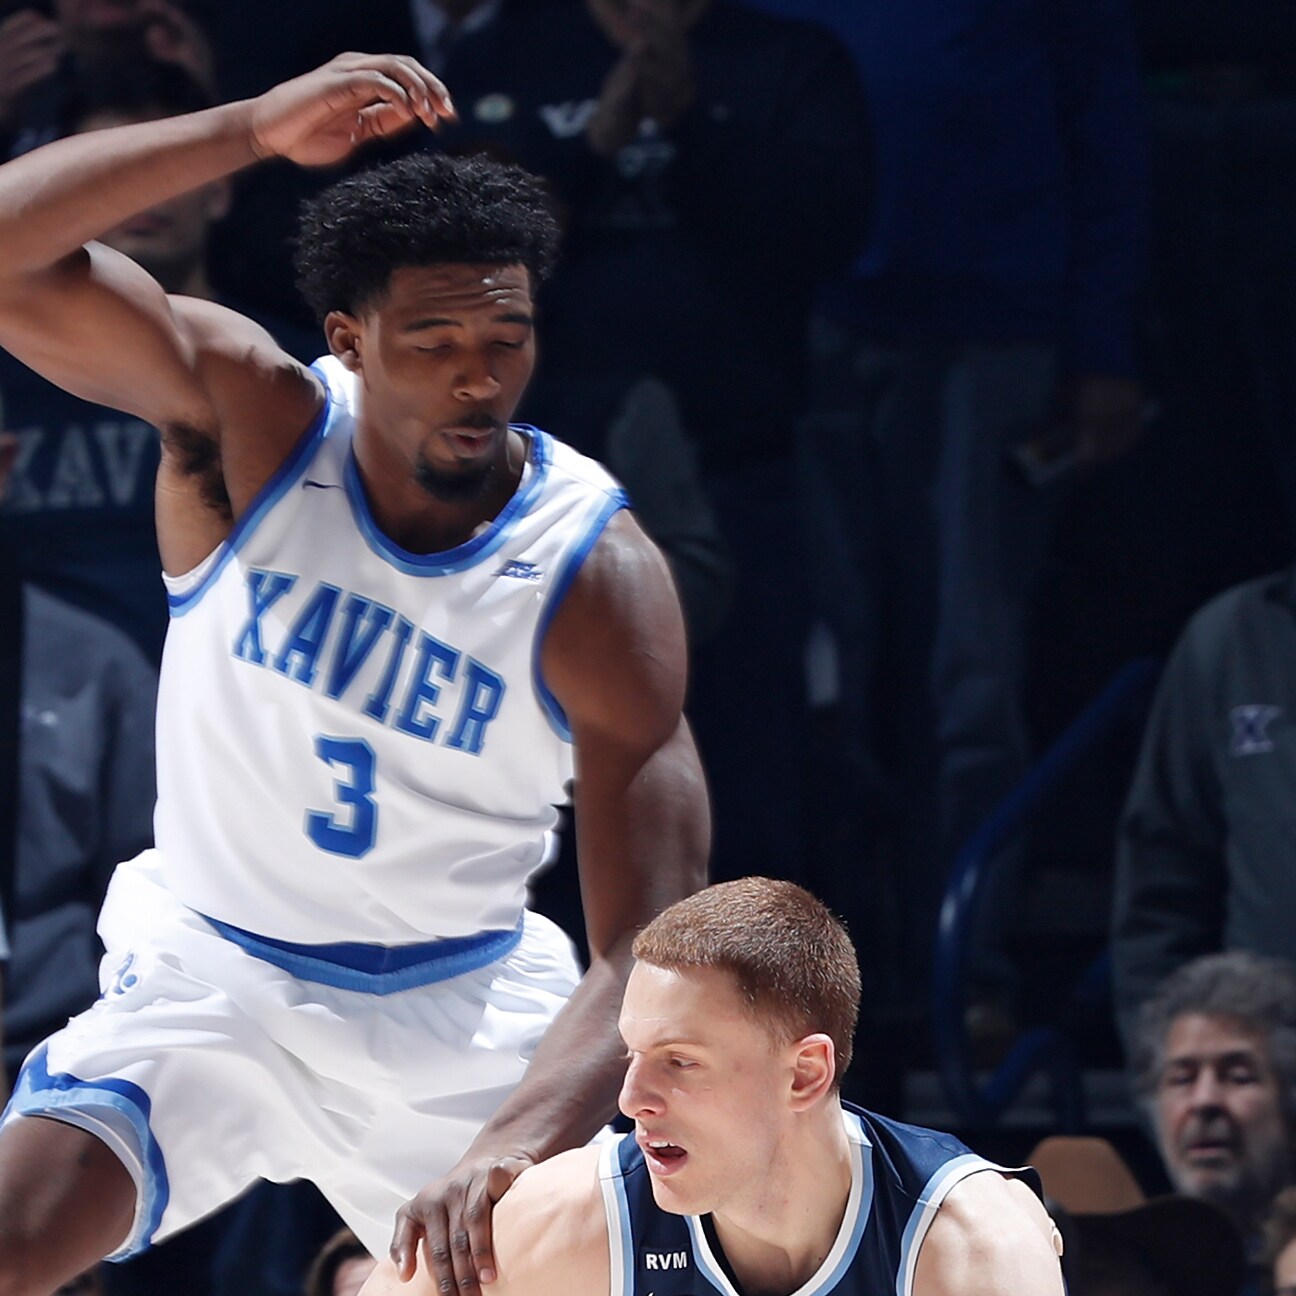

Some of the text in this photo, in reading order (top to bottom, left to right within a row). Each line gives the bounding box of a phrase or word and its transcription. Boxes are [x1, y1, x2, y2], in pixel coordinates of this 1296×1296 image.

[229, 566, 508, 758] XAVIER
[303, 731, 379, 861] 3
[645, 1251, 688, 1271] RVM
